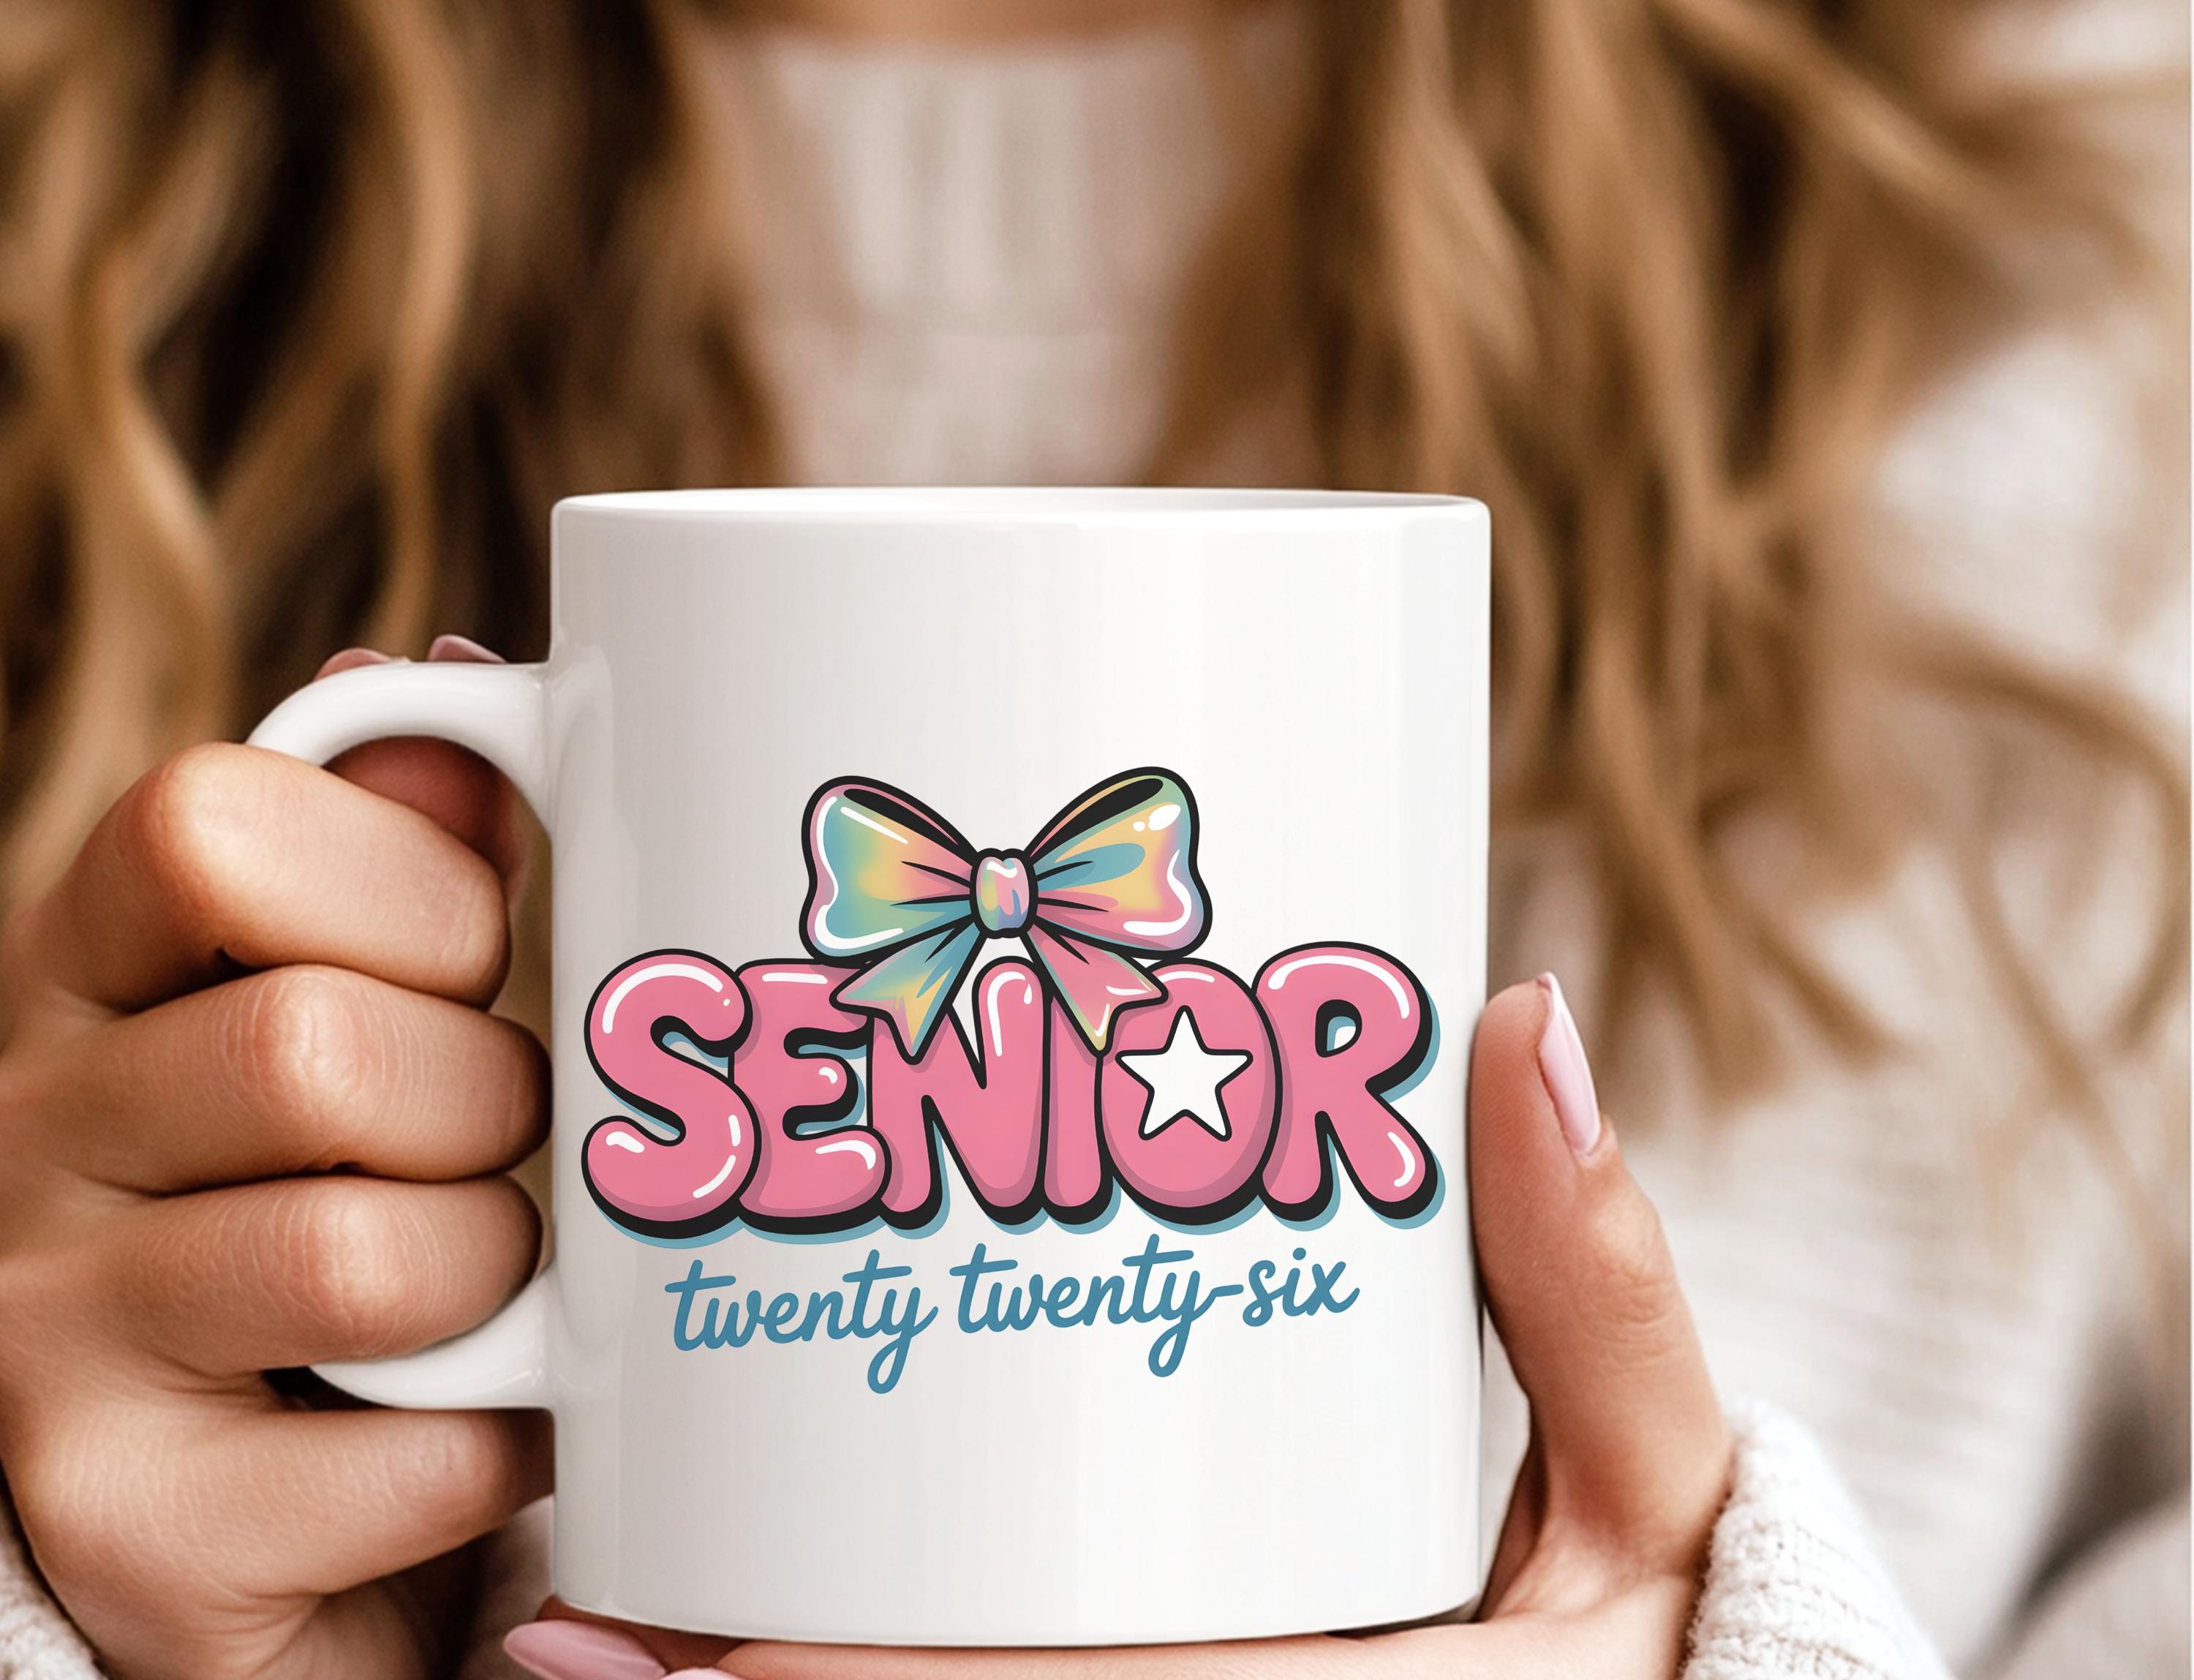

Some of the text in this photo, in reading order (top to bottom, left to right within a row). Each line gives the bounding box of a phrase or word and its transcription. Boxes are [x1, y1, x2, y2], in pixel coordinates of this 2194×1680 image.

[582, 941, 1441, 1243] SENIOR
[664, 1234, 1360, 1395] twenty twenty-six
